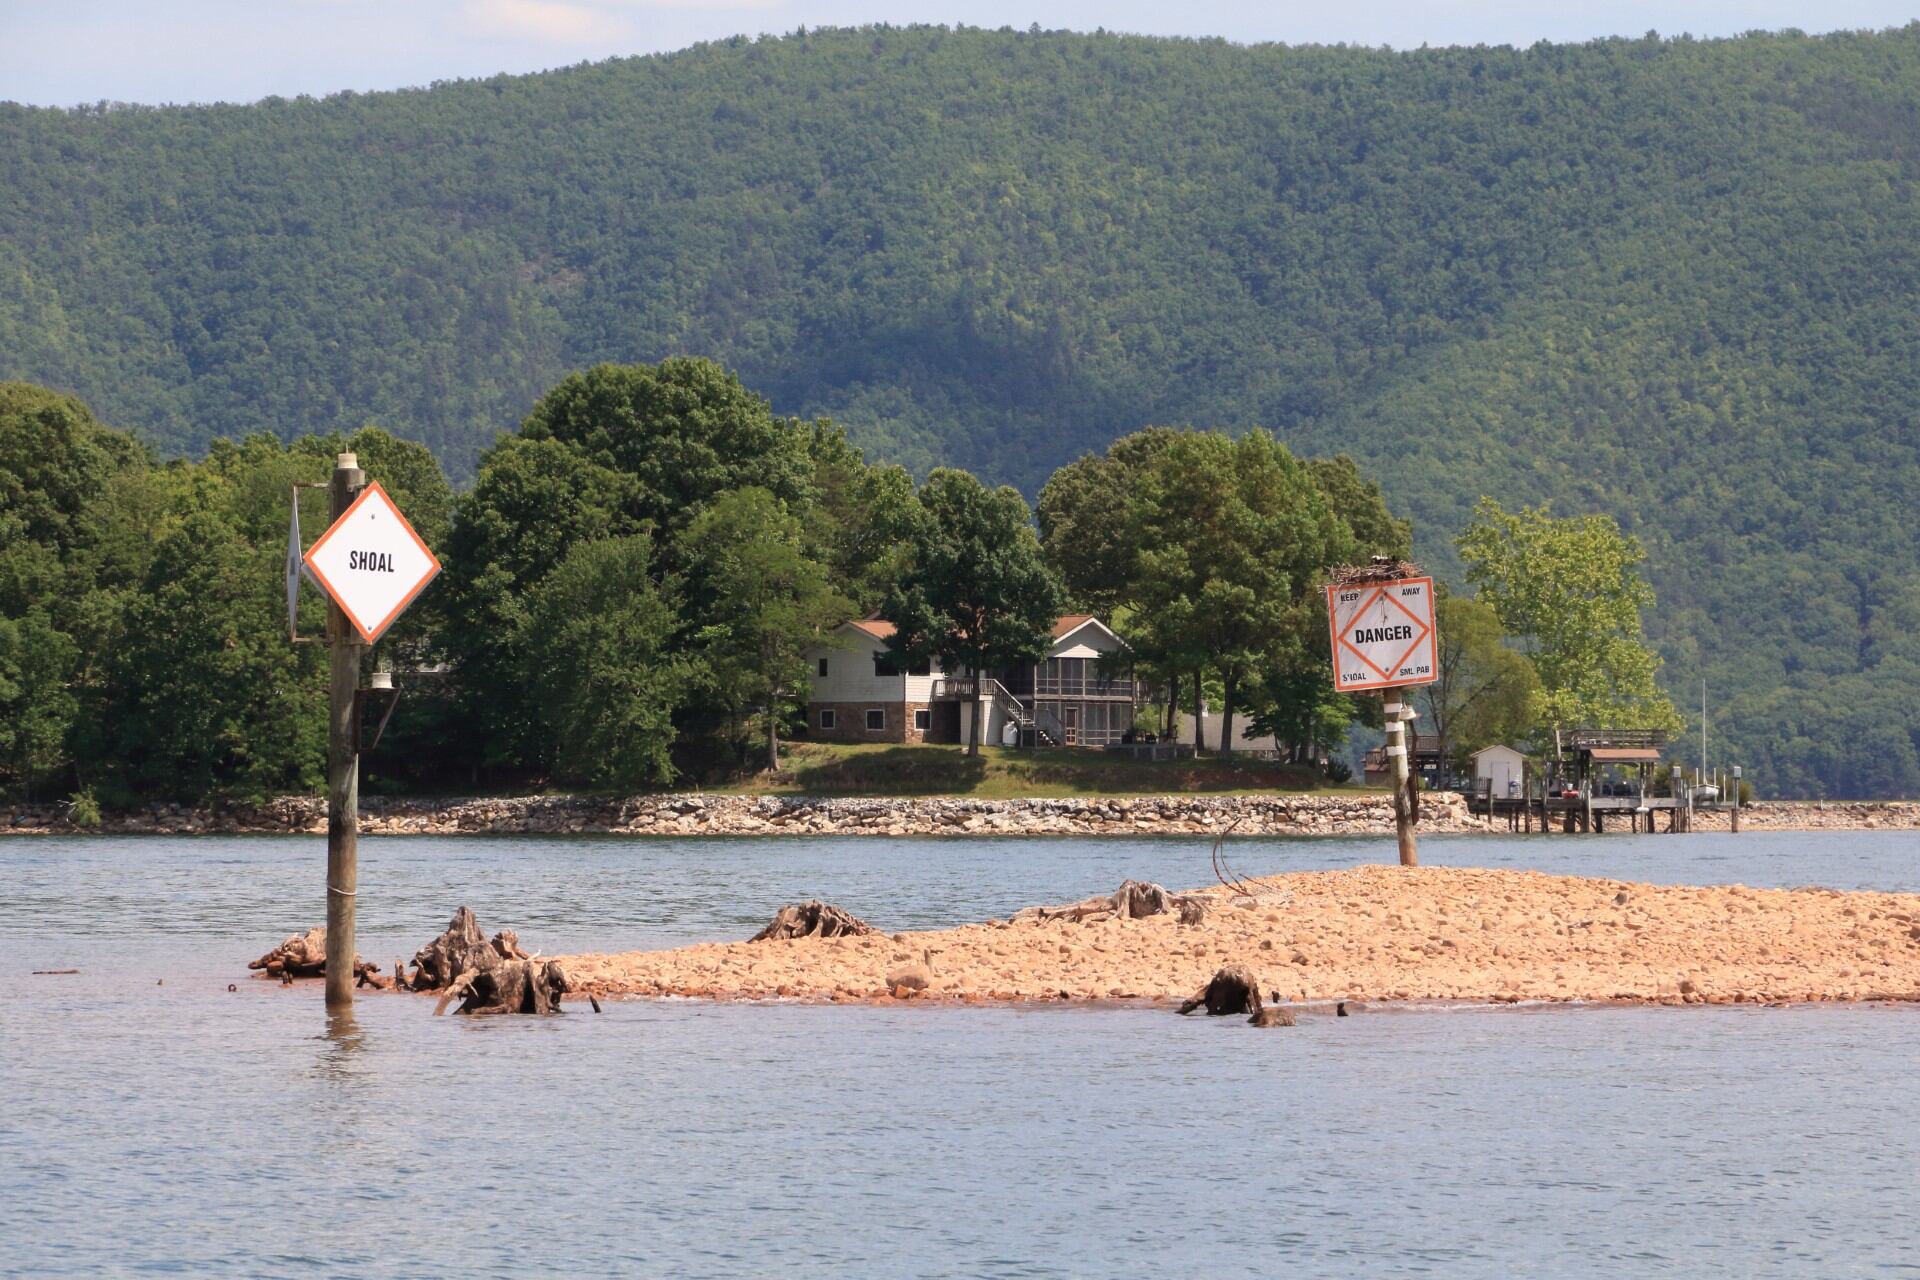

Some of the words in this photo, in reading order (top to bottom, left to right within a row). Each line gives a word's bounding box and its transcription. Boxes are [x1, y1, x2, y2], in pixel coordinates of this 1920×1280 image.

[349, 550, 395, 573] SHOAL
[1340, 593, 1359, 602] KEEP
[1402, 587, 1421, 596] AWAY
[1355, 625, 1412, 643] DANGER
